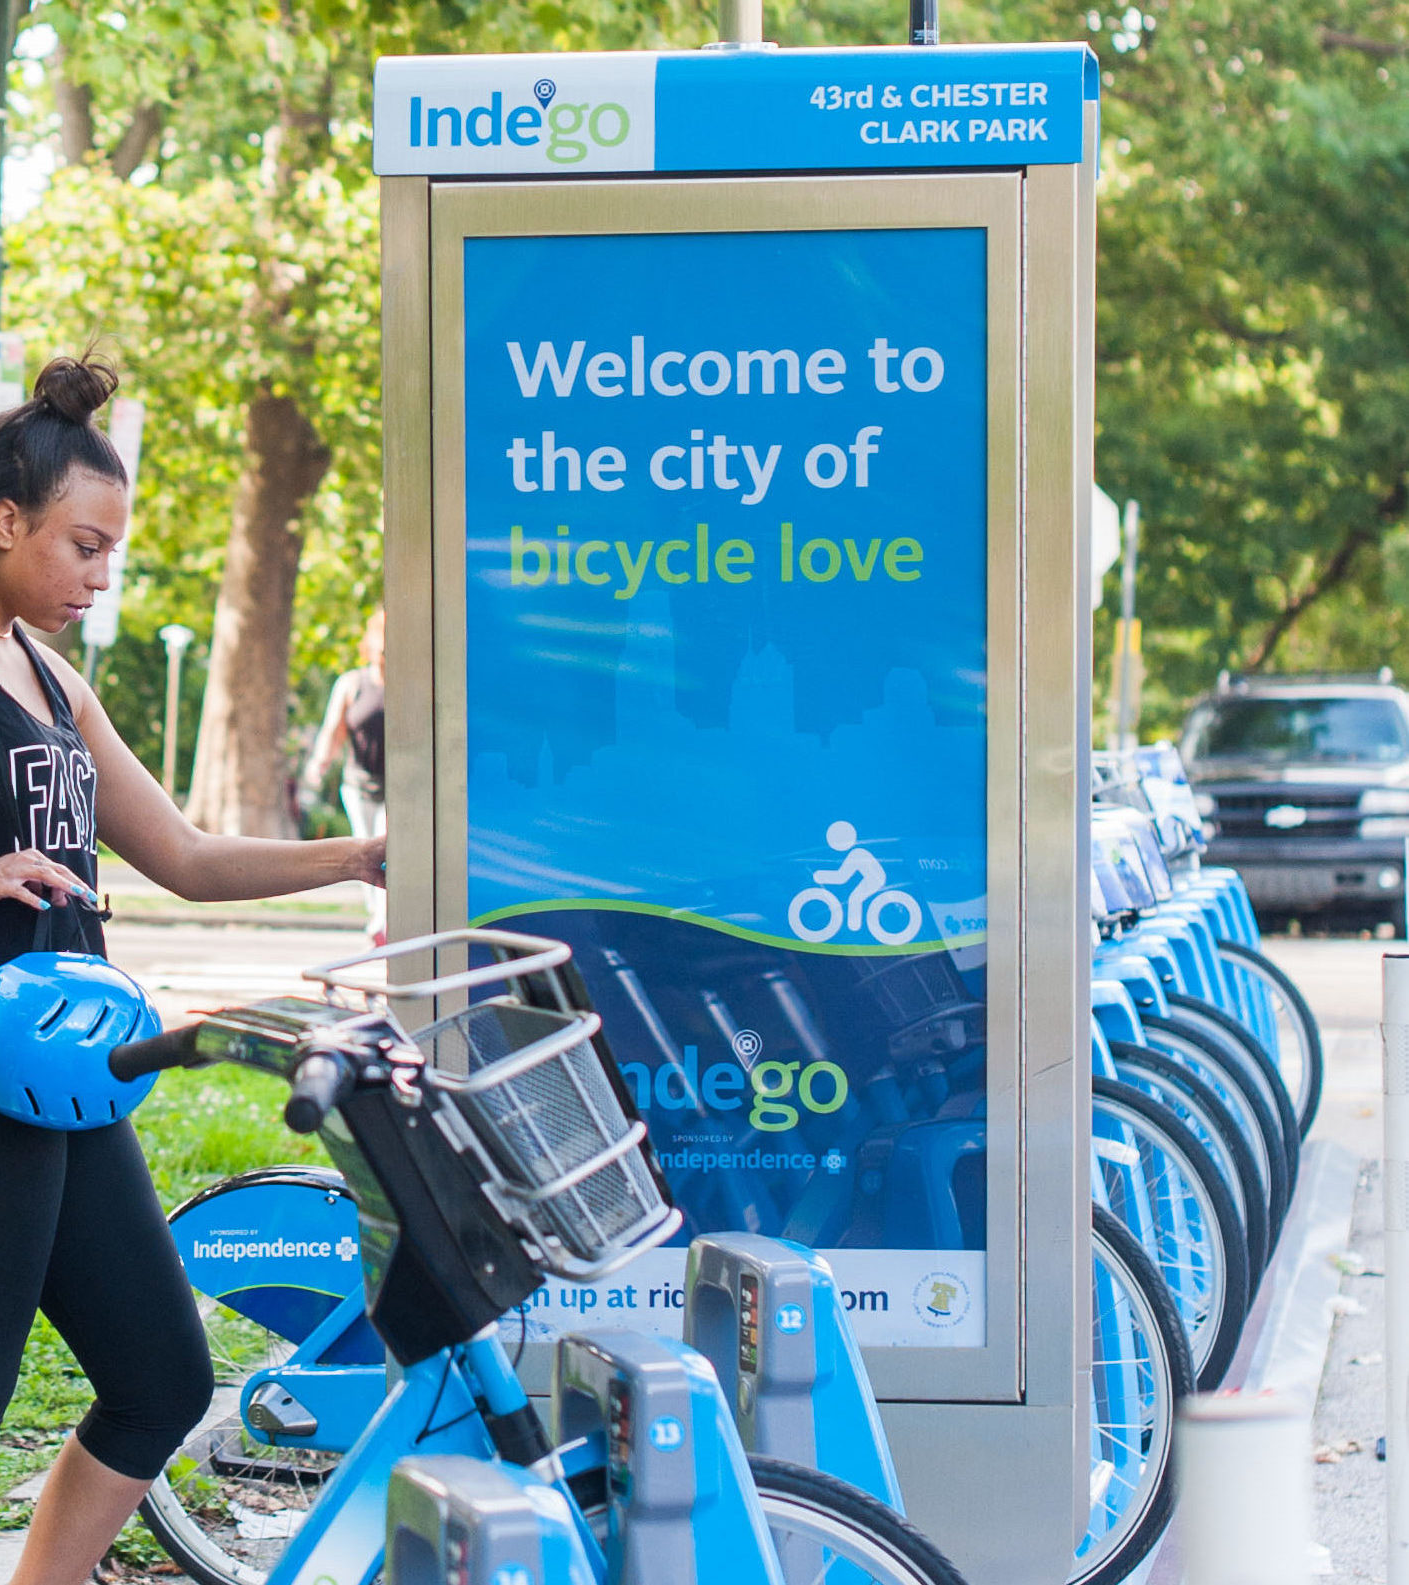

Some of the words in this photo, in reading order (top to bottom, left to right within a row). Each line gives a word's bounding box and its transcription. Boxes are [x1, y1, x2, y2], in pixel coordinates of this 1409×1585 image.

[809, 84, 873, 111] 43rd
[880, 84, 903, 109] &
[909, 82, 1048, 108] CHESTER
[410, 90, 630, 164] Indego
[859, 119, 961, 145] CLARK
[968, 117, 1048, 143] PARK
[506, 335, 847, 398] Welcome
[867, 337, 945, 394] to
[505, 430, 627, 493] the
[649, 429, 783, 506] city
[804, 425, 884, 489] of
[509, 523, 755, 601] bicycle
[780, 522, 924, 583] love
[617, 1045, 849, 1133] ndego
[654, 1148, 816, 1174] ndependence
[193, 1237, 331, 1263] Independence
[560, 1287, 598, 1314] up
[606, 1284, 638, 1309] at
[780, 1310, 803, 1328] 12
[655, 1422, 681, 1445] 13
